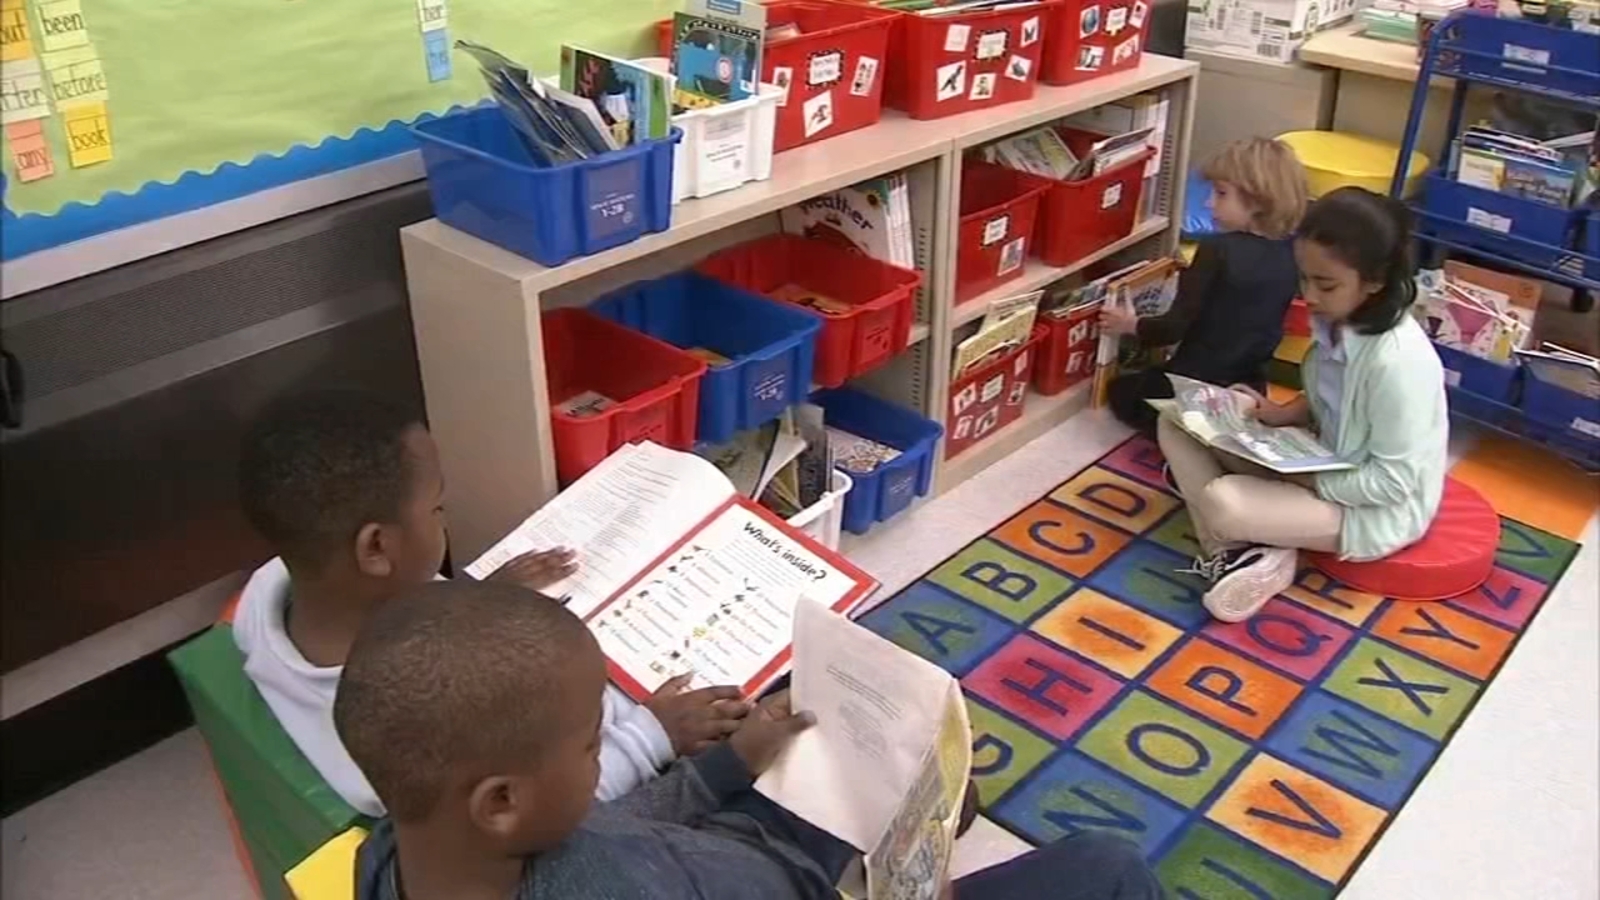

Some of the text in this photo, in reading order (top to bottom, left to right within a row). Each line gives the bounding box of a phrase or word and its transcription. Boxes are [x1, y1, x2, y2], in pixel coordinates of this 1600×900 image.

[38, 5, 85, 36] been
[51, 65, 108, 101] before
[67, 119, 107, 151] book
[781, 549, 828, 584] inside?
[900, 610, 977, 656] A
[960, 561, 1038, 601] B
[1029, 520, 1096, 556] C
[1077, 483, 1147, 517] D
[1400, 608, 1480, 651] Y
[1000, 658, 1094, 716] H
[1077, 616, 1146, 652] I
[1126, 723, 1212, 777] O
[1185, 665, 1258, 718] P
[1246, 613, 1333, 658] Q
[1357, 657, 1450, 717] X
[1300, 709, 1400, 780] W
[1245, 779, 1343, 840] V
